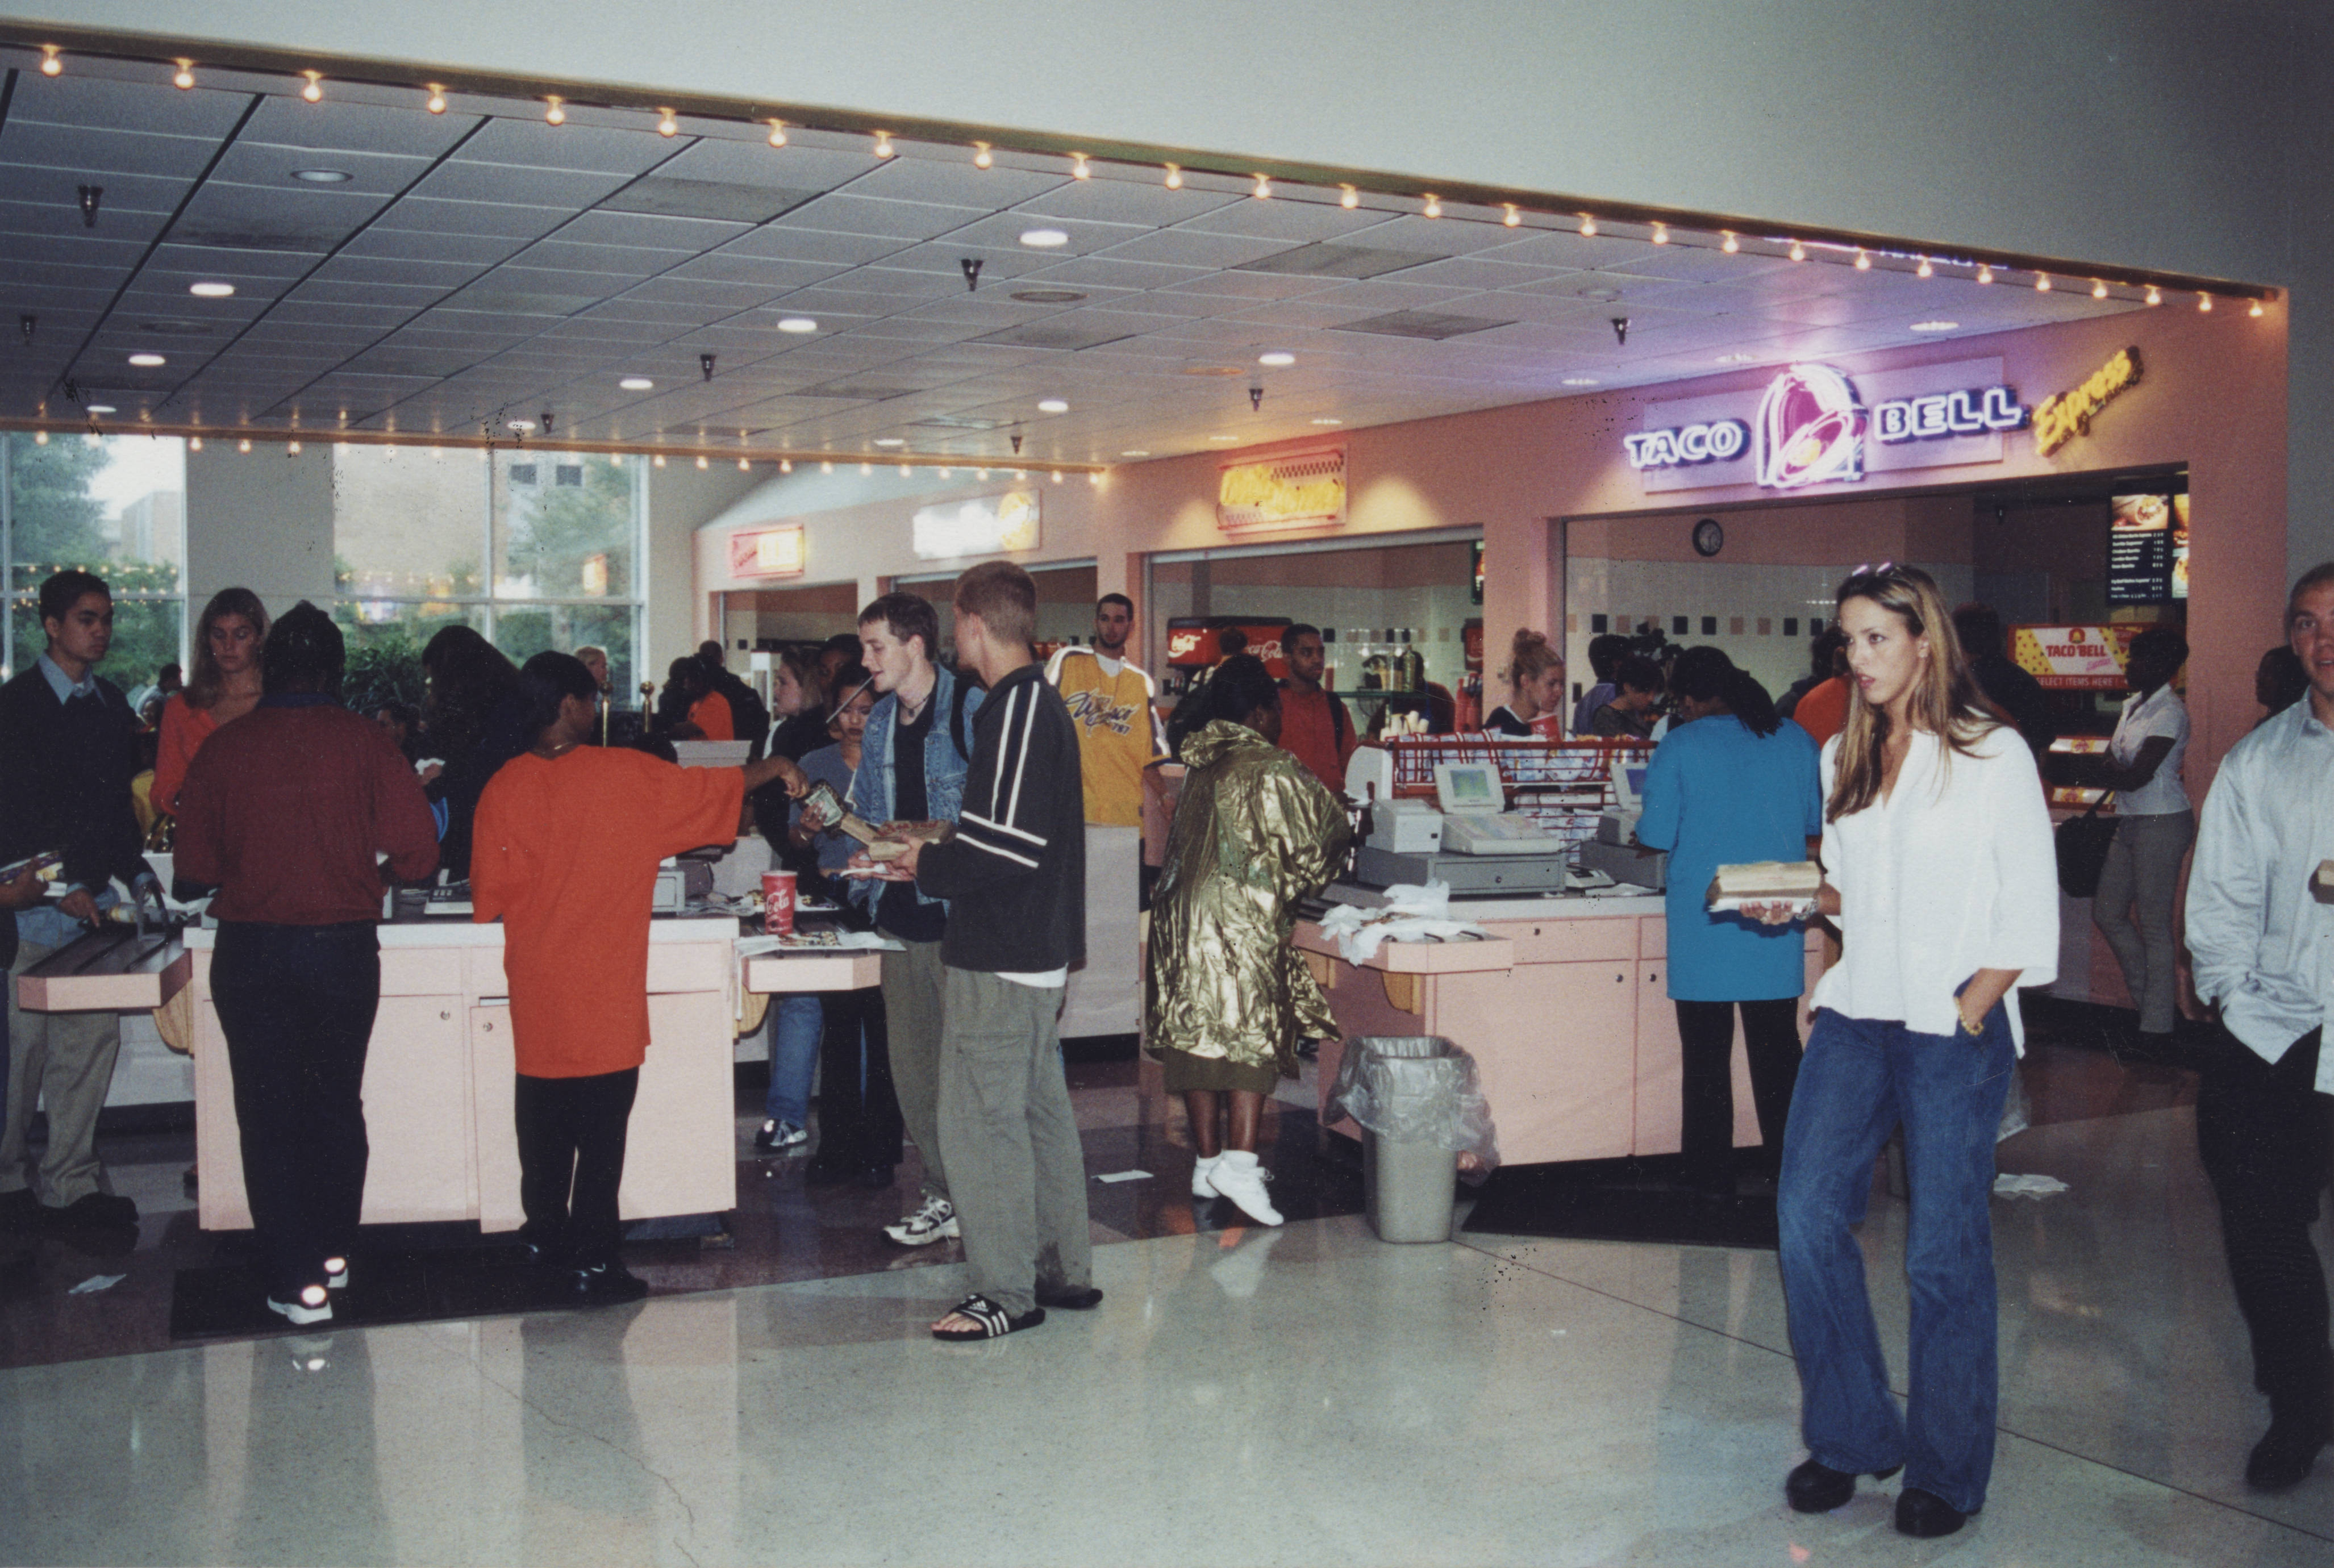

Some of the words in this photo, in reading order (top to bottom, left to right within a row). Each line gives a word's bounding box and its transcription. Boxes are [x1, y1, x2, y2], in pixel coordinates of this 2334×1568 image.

[1623, 420, 1745, 468] TACO
[1874, 388, 2024, 441] BELL
[2046, 645, 2075, 657] TACO
[2077, 645, 2107, 657] BELL
[2066, 677, 2089, 686] ITEMS
[2092, 677, 2113, 686] HERE
